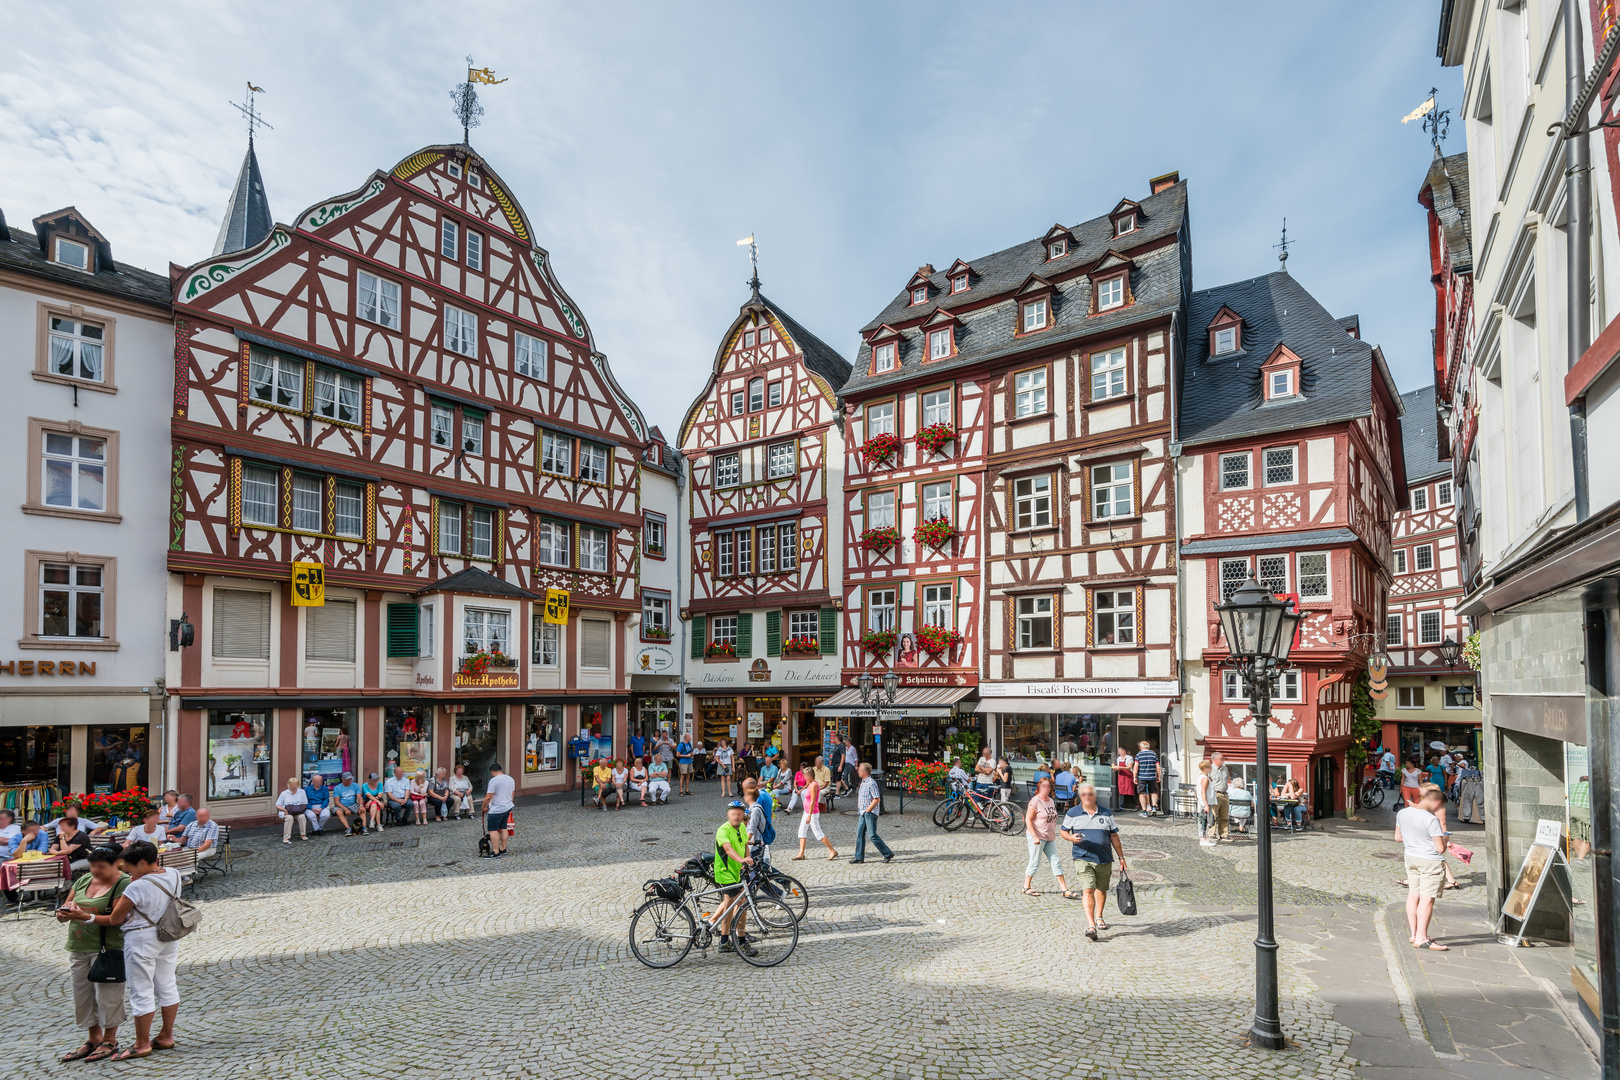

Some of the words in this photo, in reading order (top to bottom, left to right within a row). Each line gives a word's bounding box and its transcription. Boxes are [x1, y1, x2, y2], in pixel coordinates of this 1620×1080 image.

[0, 660, 96, 675] HERRN
[784, 670, 802, 681] Die
[803, 663, 838, 680] Lohner's
[415, 672, 435, 686] Apotheke
[480, 673, 518, 687] Apotheke
[703, 668, 736, 683] Bäckerei
[906, 675, 948, 685] Schnitzius
[1027, 684, 1060, 694] Eiscafé
[1063, 685, 1120, 694] Bressanone
